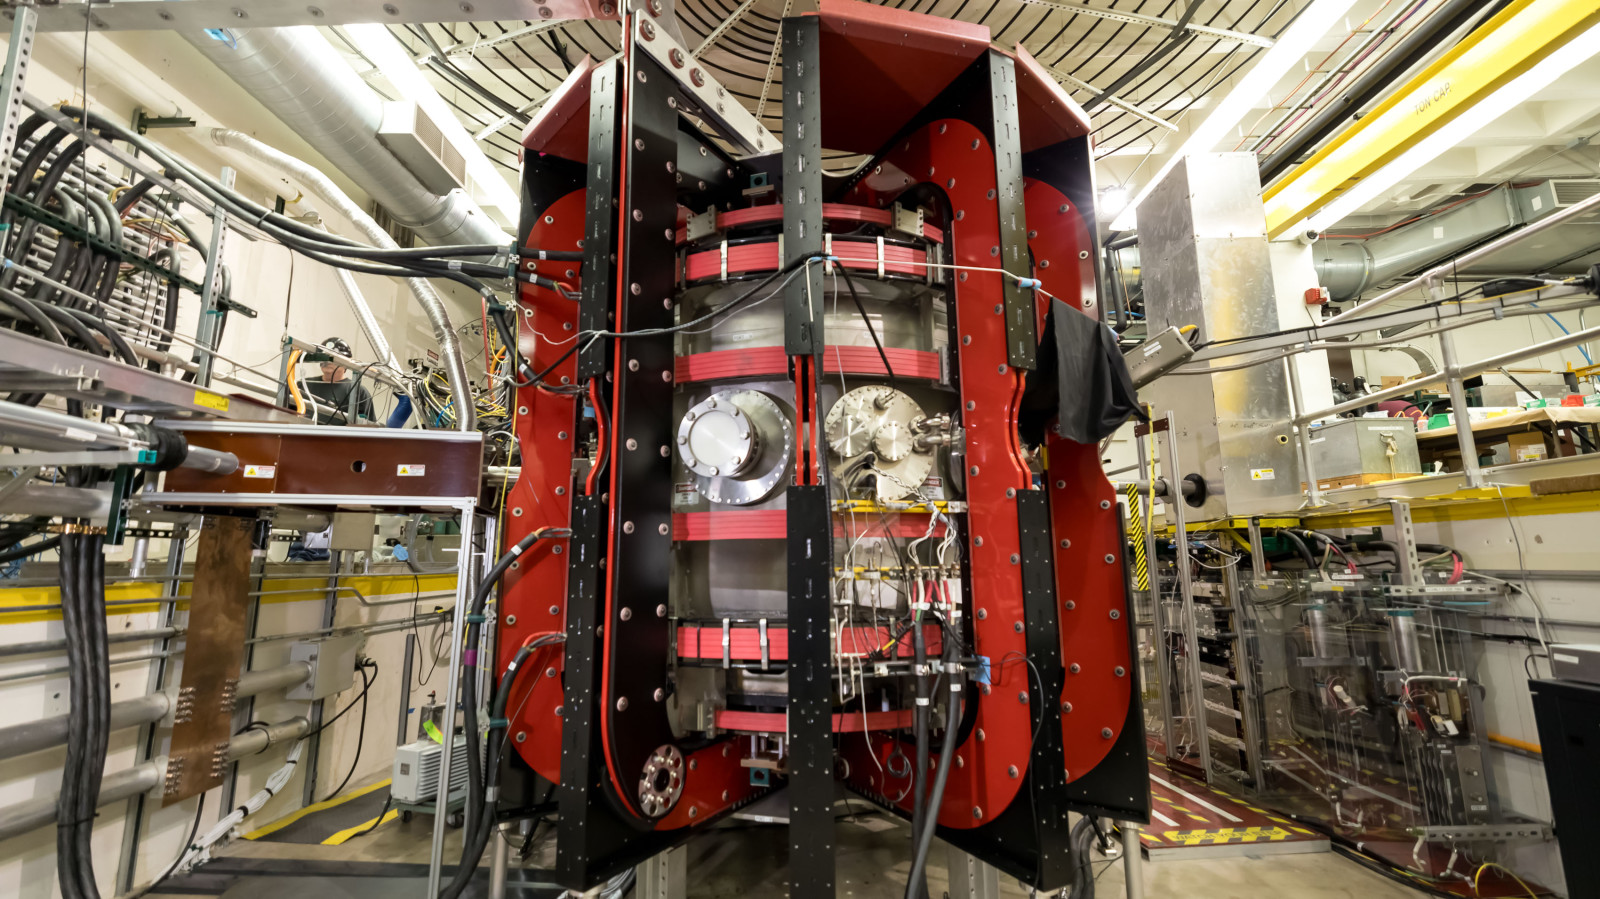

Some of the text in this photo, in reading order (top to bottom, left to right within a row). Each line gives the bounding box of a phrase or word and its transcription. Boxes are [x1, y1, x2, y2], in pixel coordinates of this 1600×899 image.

[1414, 96, 1431, 115] TON
[1173, 833, 1215, 841] WATCH
[1218, 831, 1253, 839] YOUR
